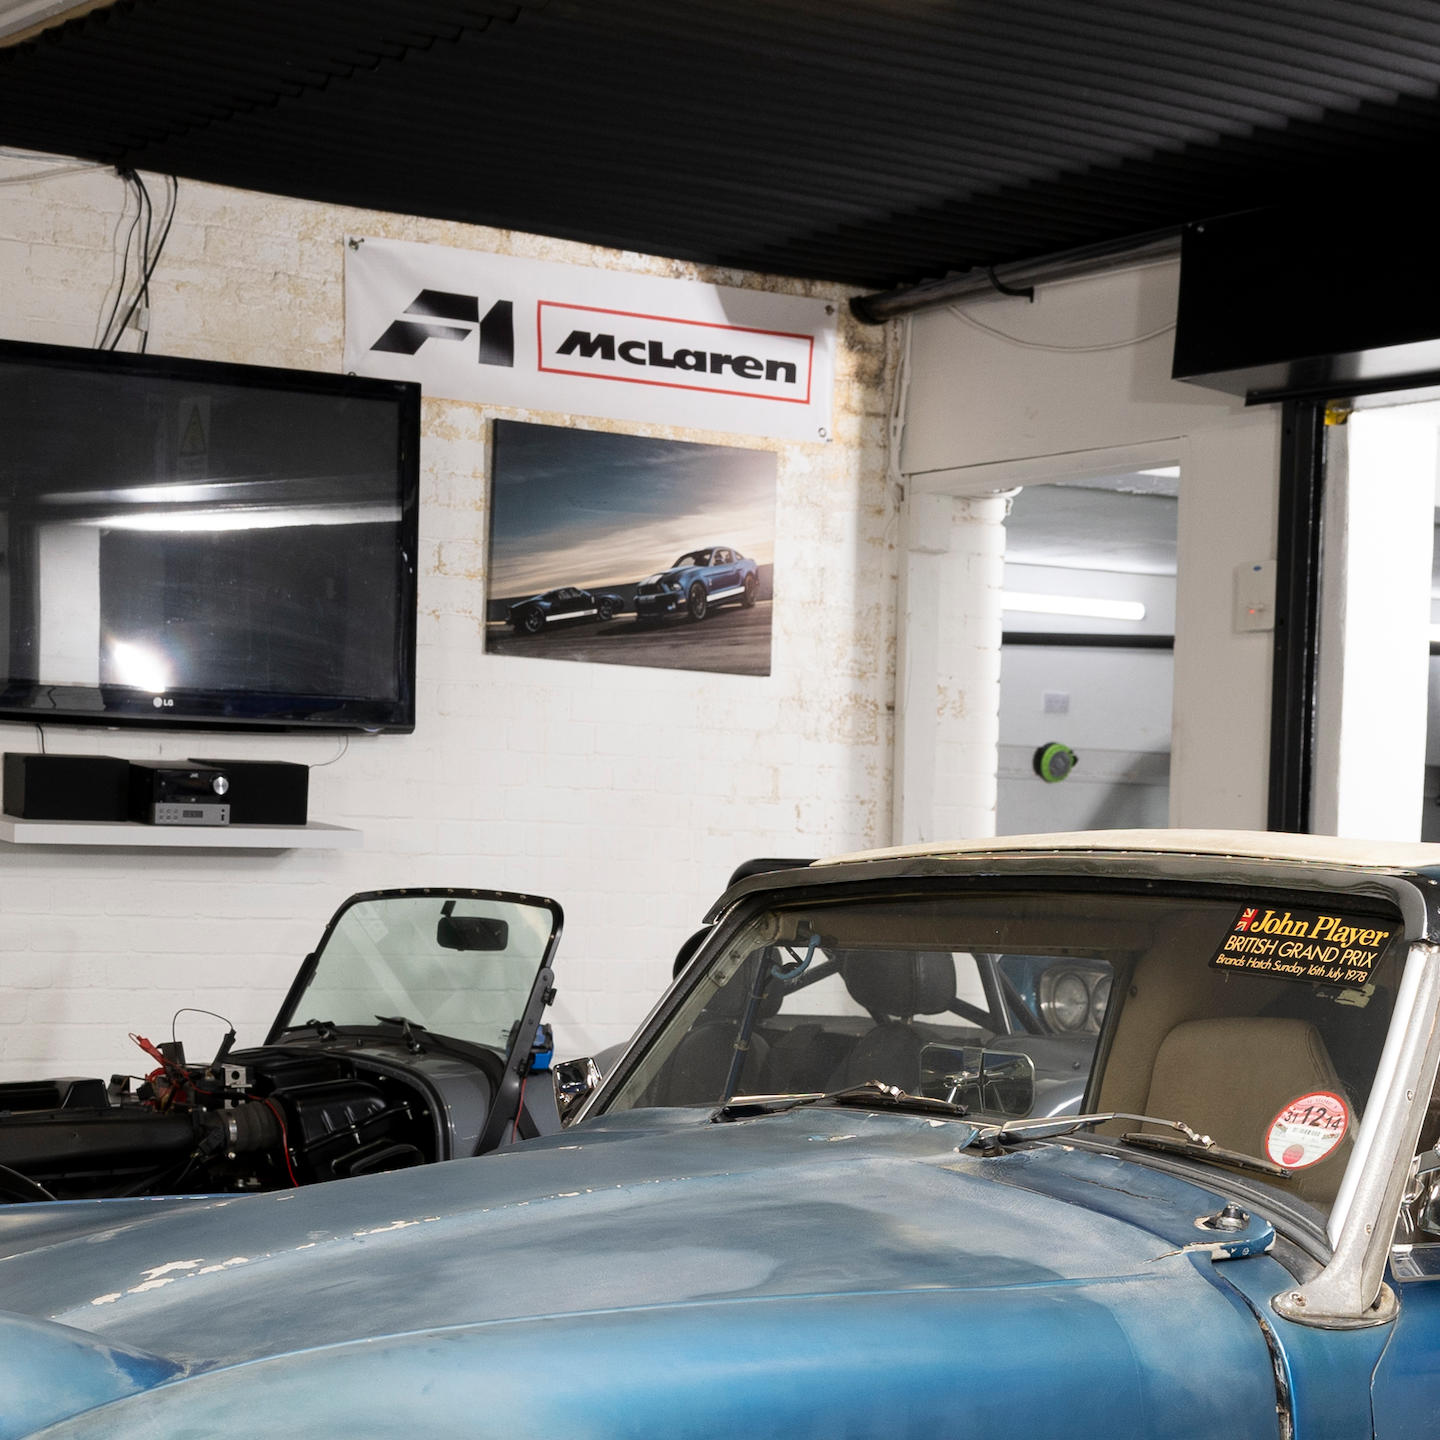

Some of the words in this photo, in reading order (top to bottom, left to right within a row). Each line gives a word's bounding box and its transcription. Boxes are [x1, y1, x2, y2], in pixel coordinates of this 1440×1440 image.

[555, 330, 797, 384] McLaren
[1250, 910, 1309, 938] John
[1307, 915, 1389, 948] Player
[1216, 953, 1246, 967] Brands
[1247, 958, 1272, 970] Hatch
[1274, 960, 1306, 976] Sunday
[1307, 964, 1326, 977] 16th
[1324, 967, 1344, 982] July
[1344, 969, 1368, 983] 1978
[1224, 935, 1279, 955] BRITISH
[1278, 941, 1339, 963] GRAND
[1339, 949, 1378, 969] PRIX
[1284, 1111, 1299, 1124] 31
[1301, 1105, 1328, 1127] 12
[1325, 1115, 1343, 1131] 14
